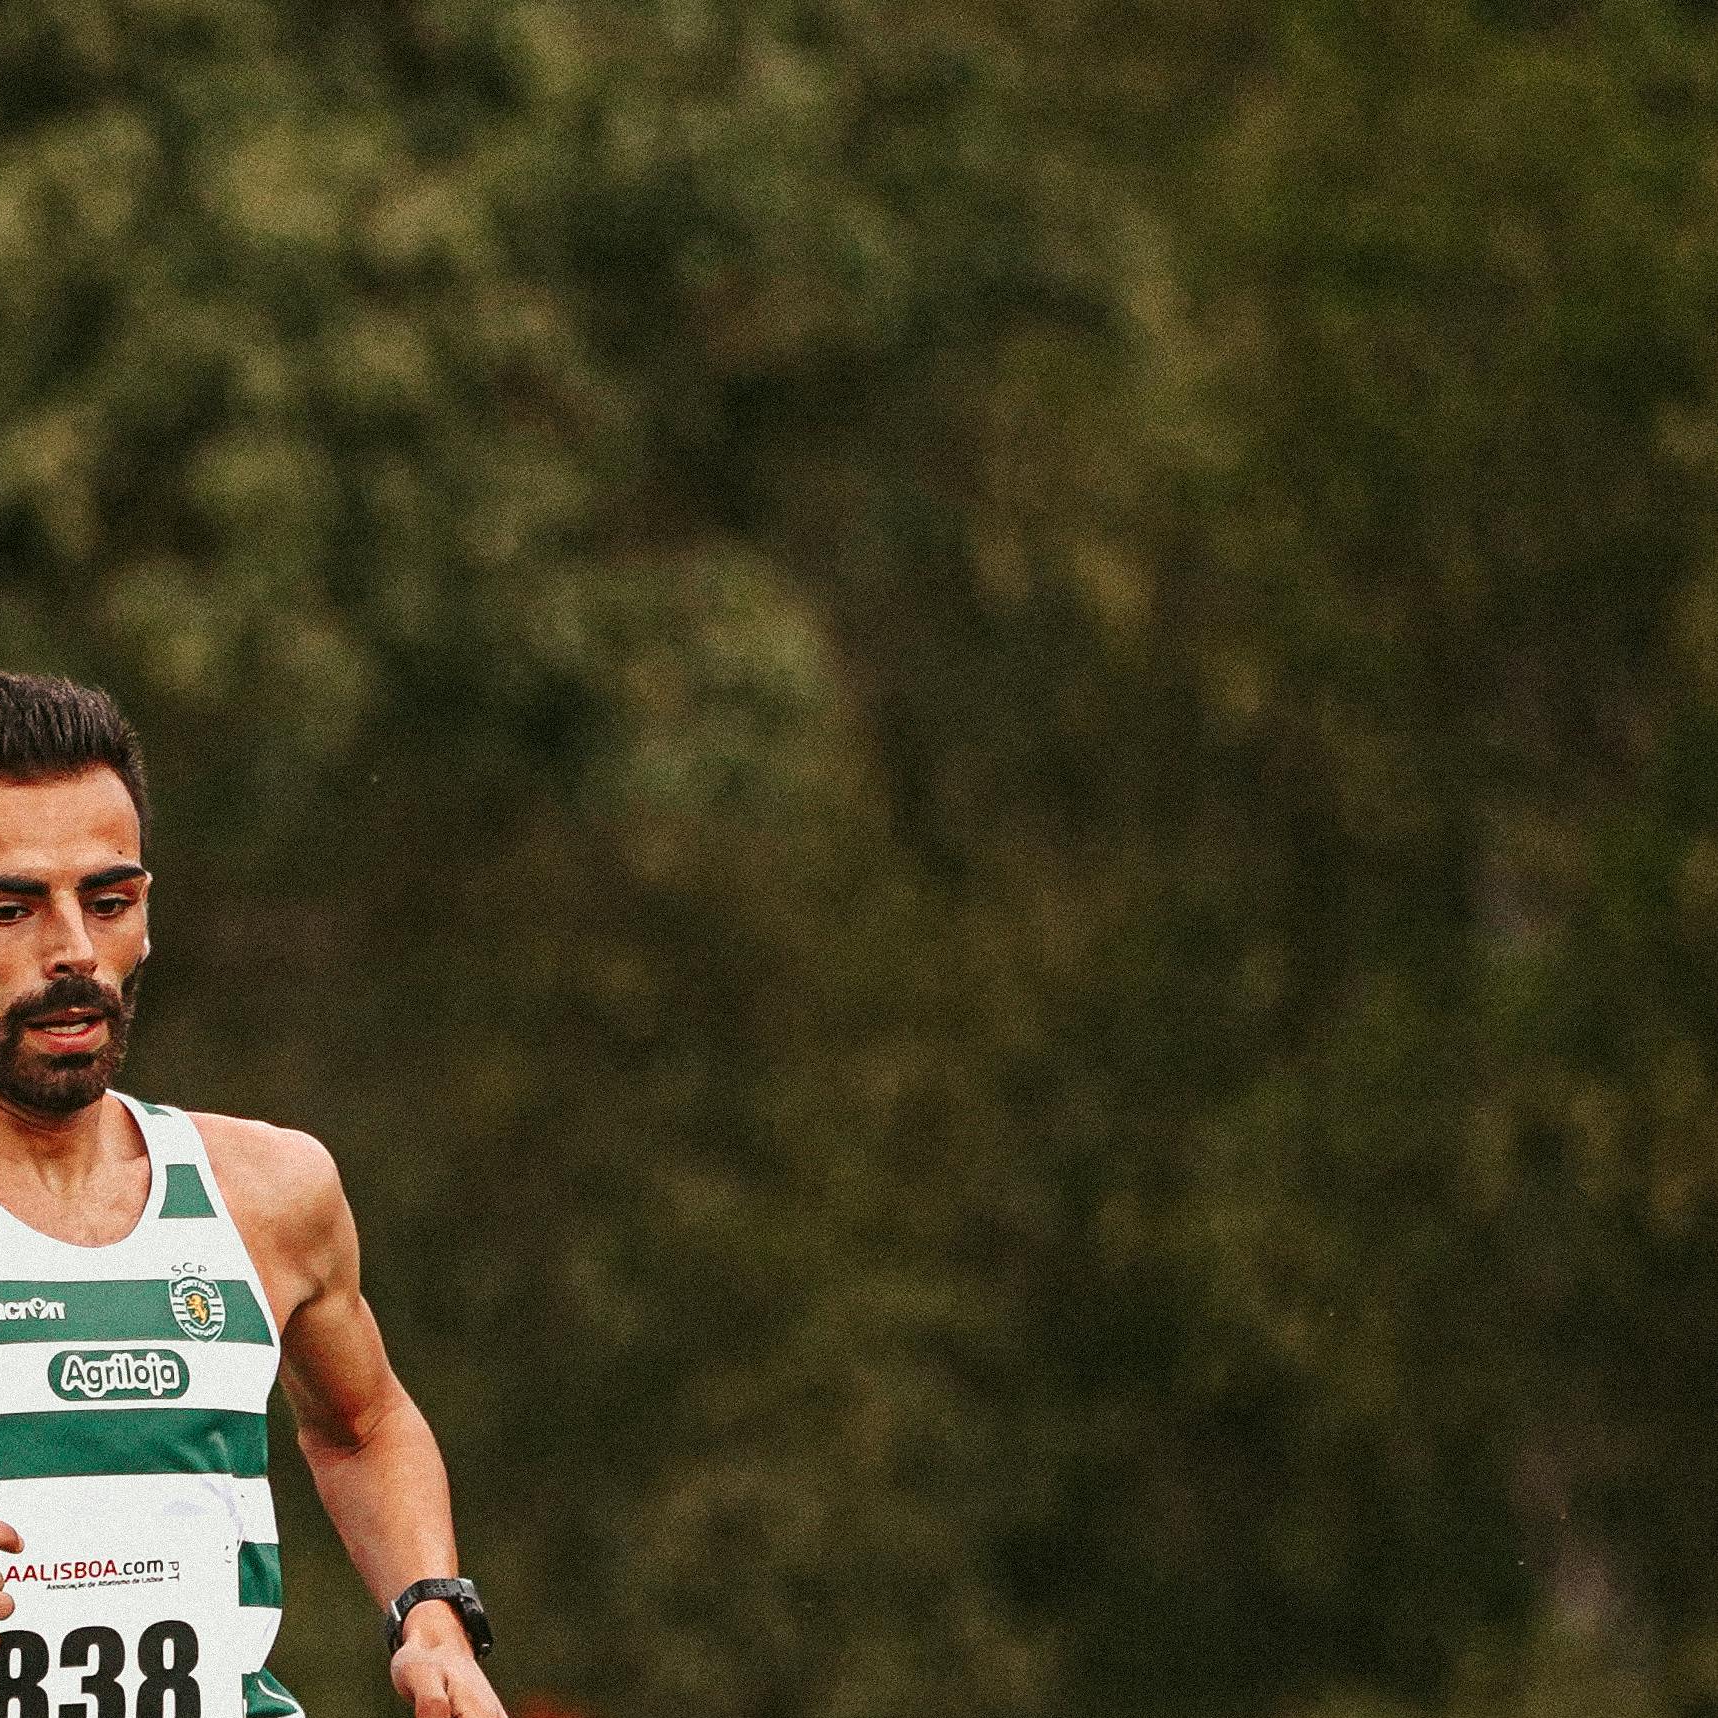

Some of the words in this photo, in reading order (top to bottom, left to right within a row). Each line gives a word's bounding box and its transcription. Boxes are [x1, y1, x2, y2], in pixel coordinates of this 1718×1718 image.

[170, 1262, 208, 1277] SCP
[60, 1352, 181, 1398] Agriloja
[4, 1558, 164, 1583] AALISBOA.com
